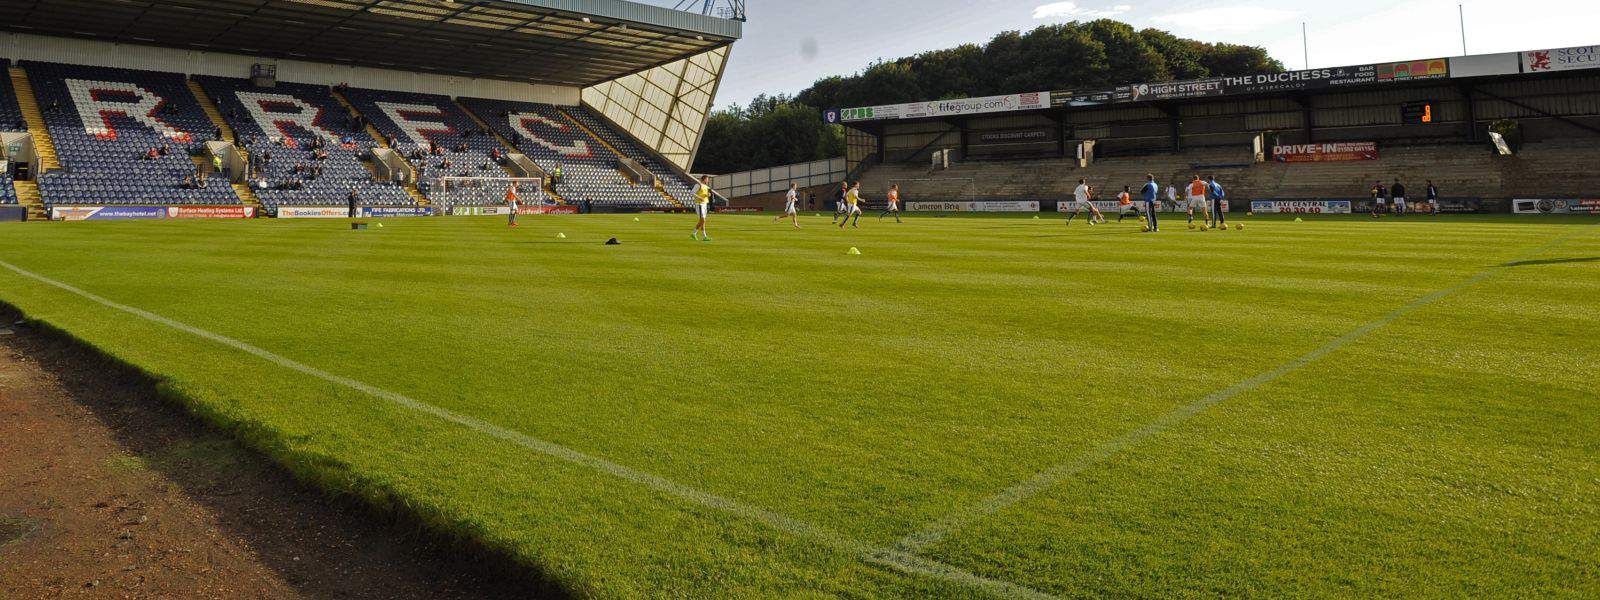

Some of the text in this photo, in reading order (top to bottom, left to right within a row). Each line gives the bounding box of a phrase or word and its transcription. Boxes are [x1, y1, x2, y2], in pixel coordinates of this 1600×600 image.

[1224, 76, 1252, 86] THE
[1257, 69, 1331, 84] DUCHESS
[1330, 77, 1375, 85] RESTAURANT
[1150, 85, 1177, 95] HIGH
[1178, 81, 1221, 93] STREET
[1273, 143, 1336, 155] DRIVE-IN
[913, 202, 943, 211] Cameron
